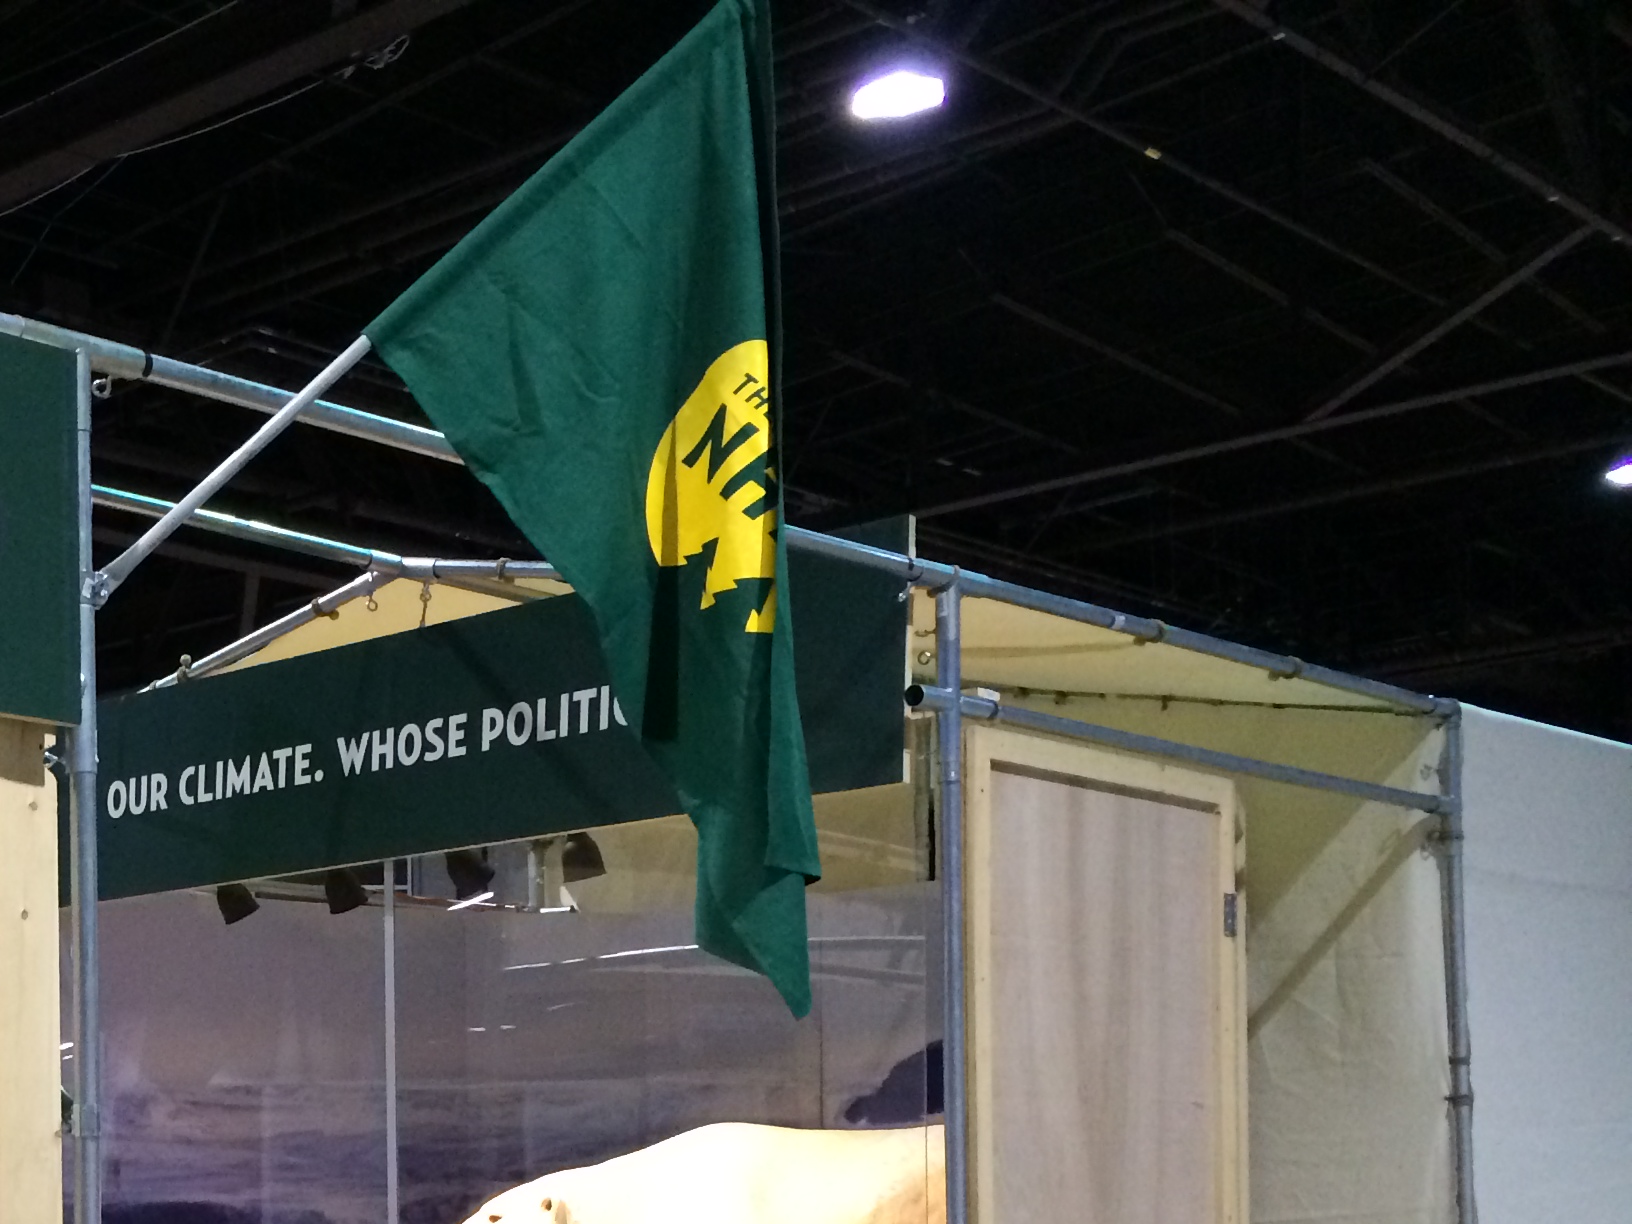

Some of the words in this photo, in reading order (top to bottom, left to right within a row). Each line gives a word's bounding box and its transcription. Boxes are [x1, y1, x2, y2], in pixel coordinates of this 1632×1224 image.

[733, 372, 770, 419] TH
[682, 403, 779, 541] NH
[107, 773, 167, 818] OUR
[179, 744, 323, 805] CLIMATE.
[337, 713, 467, 776] WHOSE
